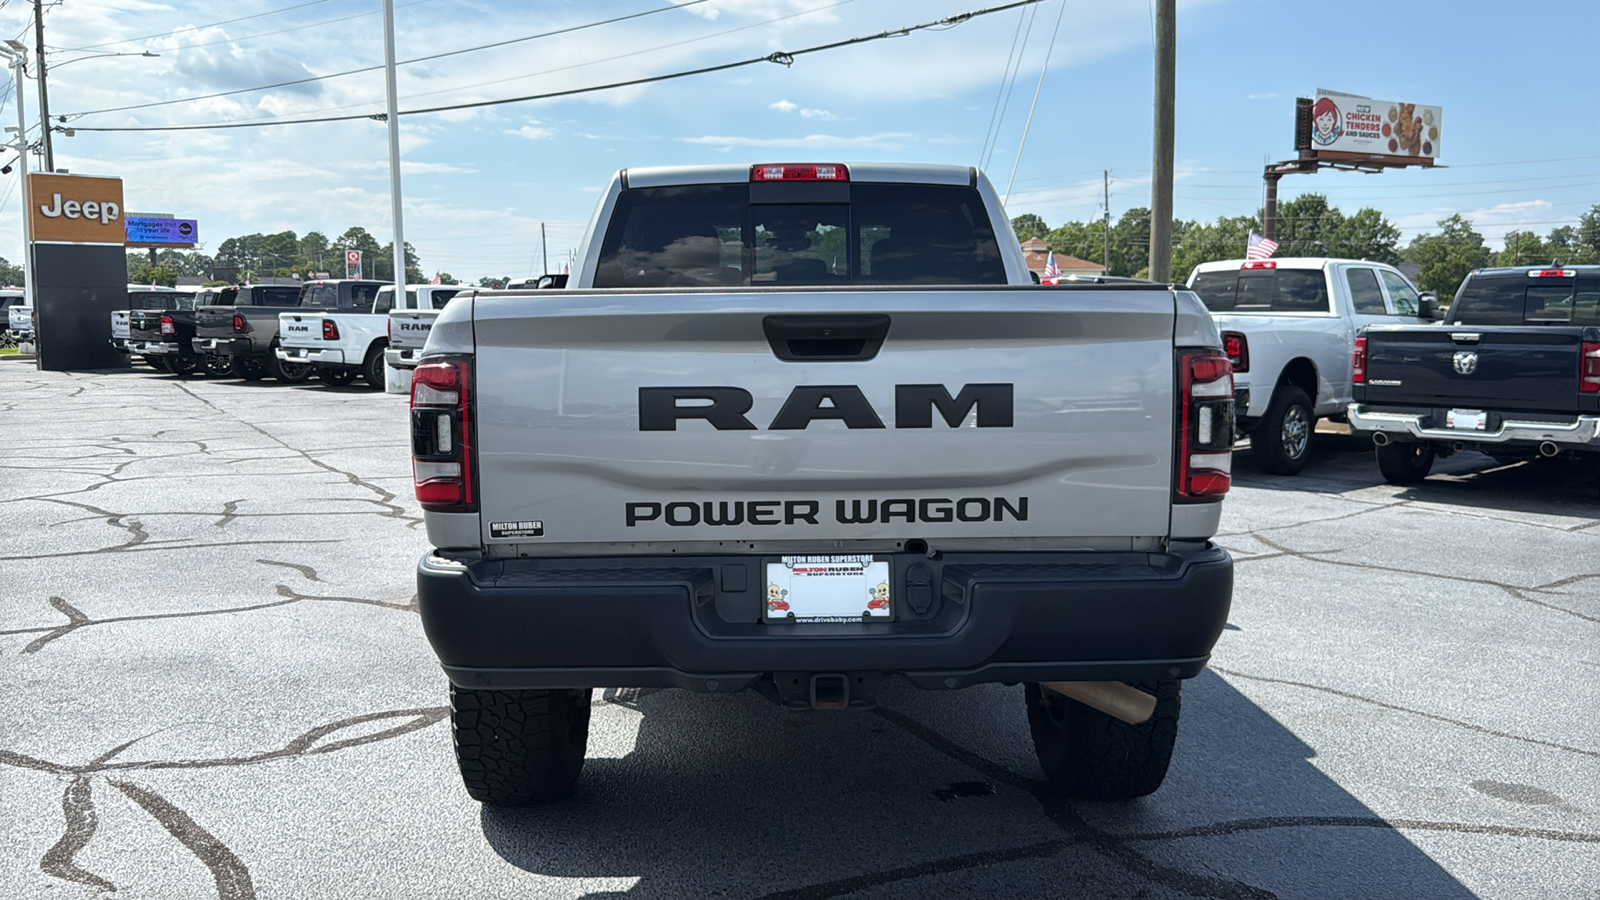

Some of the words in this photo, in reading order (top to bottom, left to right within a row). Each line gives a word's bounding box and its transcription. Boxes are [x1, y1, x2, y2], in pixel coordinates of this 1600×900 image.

[1346, 112, 1381, 122] CHICKEN
[1345, 121, 1380, 131] TENDERS
[1359, 131, 1380, 139] SAUCES
[40, 193, 119, 224] Jeep
[128, 220, 163, 228] Mortgages
[401, 323, 431, 331] RAM
[638, 383, 1014, 431] RAM
[625, 500, 819, 527] POWER
[835, 497, 1029, 524] WAGON
[492, 522, 517, 530] MILTON
[519, 521, 541, 529] RUBEN
[781, 555, 806, 563] MILTON
[807, 555, 830, 563] RUBEN
[831, 554, 874, 563] SUPERSTORE
[796, 616, 862, 624] www.drivebaby.com
